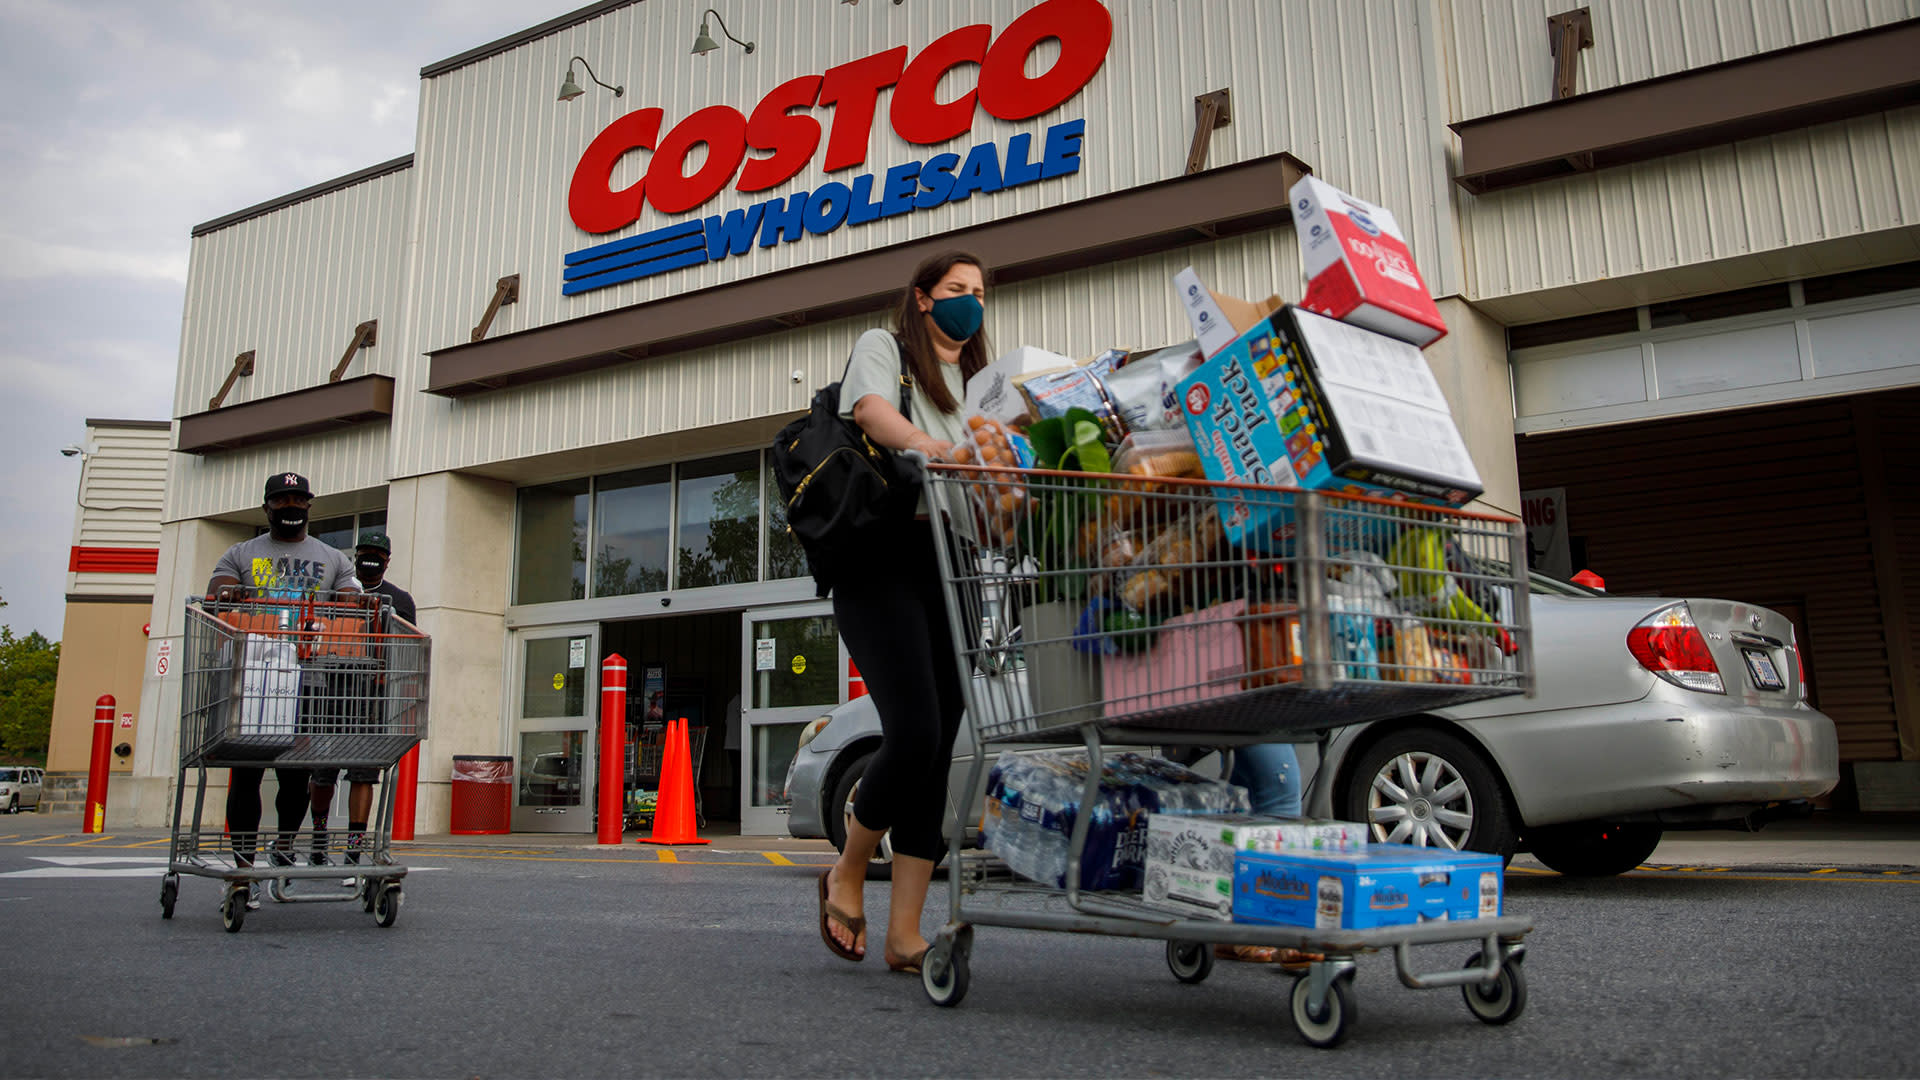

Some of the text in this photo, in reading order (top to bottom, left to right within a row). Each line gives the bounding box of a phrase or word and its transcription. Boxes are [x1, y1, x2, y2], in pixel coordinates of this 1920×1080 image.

[568, 0, 1112, 234] COSTCO
[704, 118, 1086, 261] WHOLESALE
[1211, 393, 1271, 485] Snack
[1219, 355, 1269, 433] Pack
[252, 557, 326, 581] MAKE
